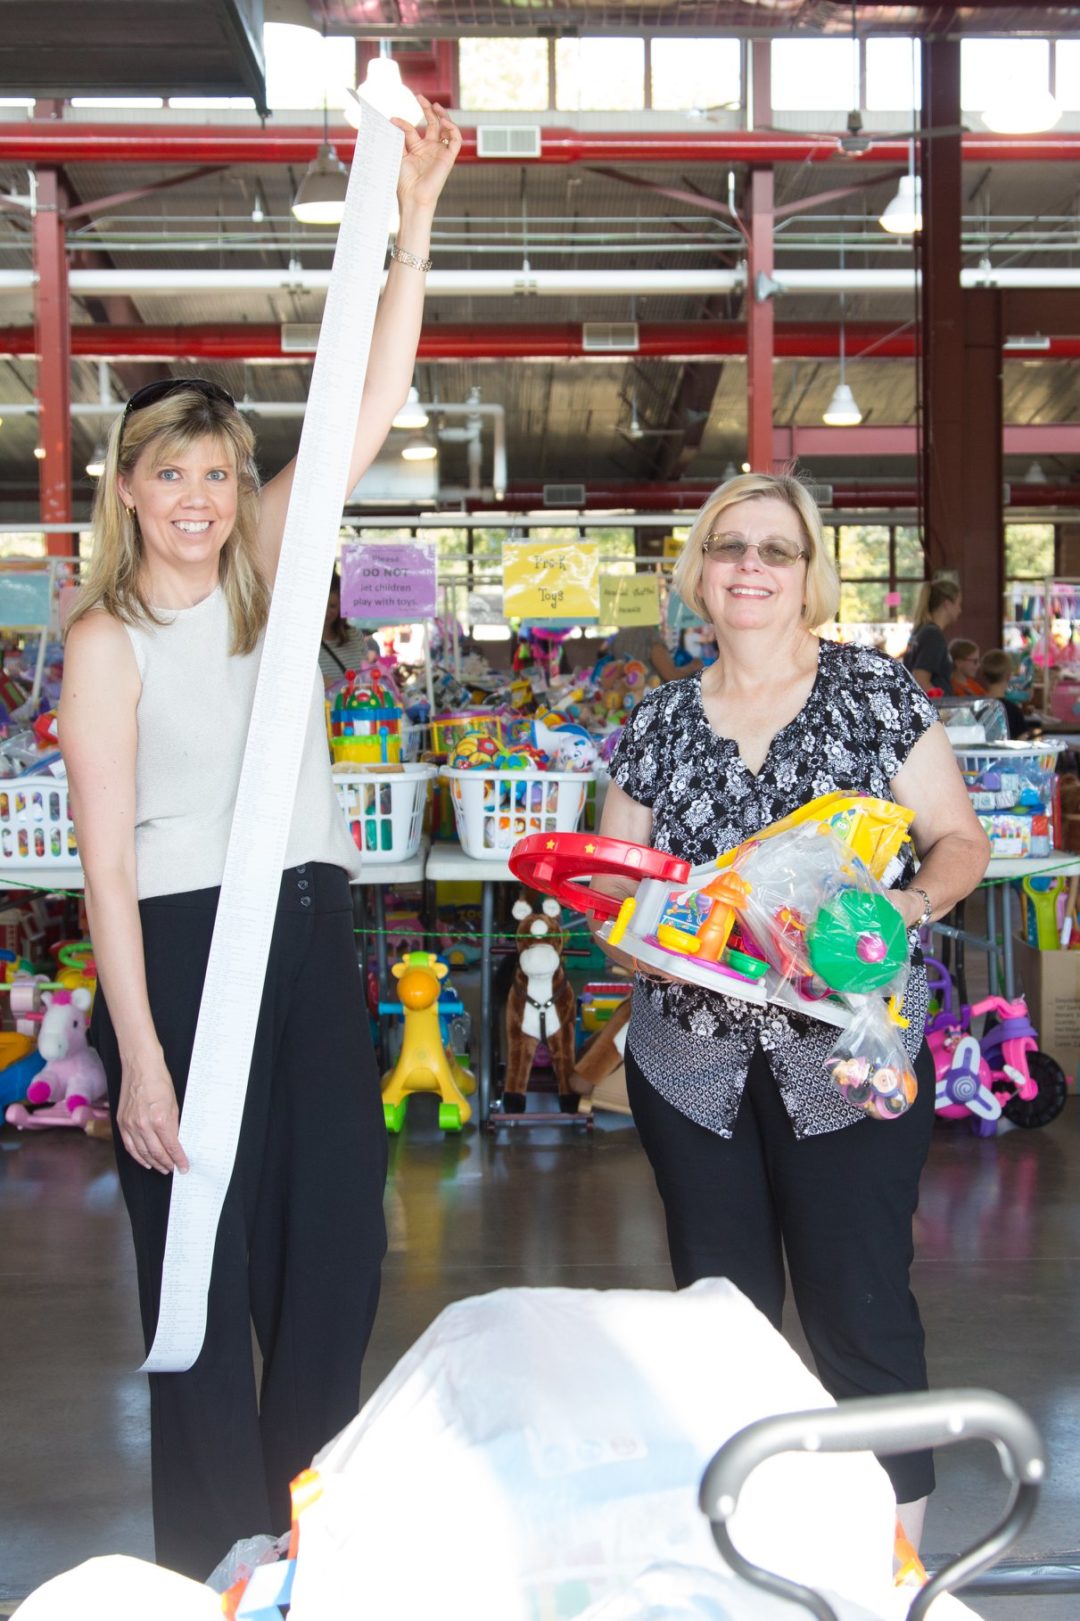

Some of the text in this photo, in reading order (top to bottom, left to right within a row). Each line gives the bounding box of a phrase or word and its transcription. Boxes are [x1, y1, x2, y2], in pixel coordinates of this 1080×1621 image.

[362, 568, 409, 577] DO NOT
[374, 583, 412, 592] children
[353, 598, 372, 607] play
[374, 597, 395, 606] with
[538, 587, 564, 609] Toys
